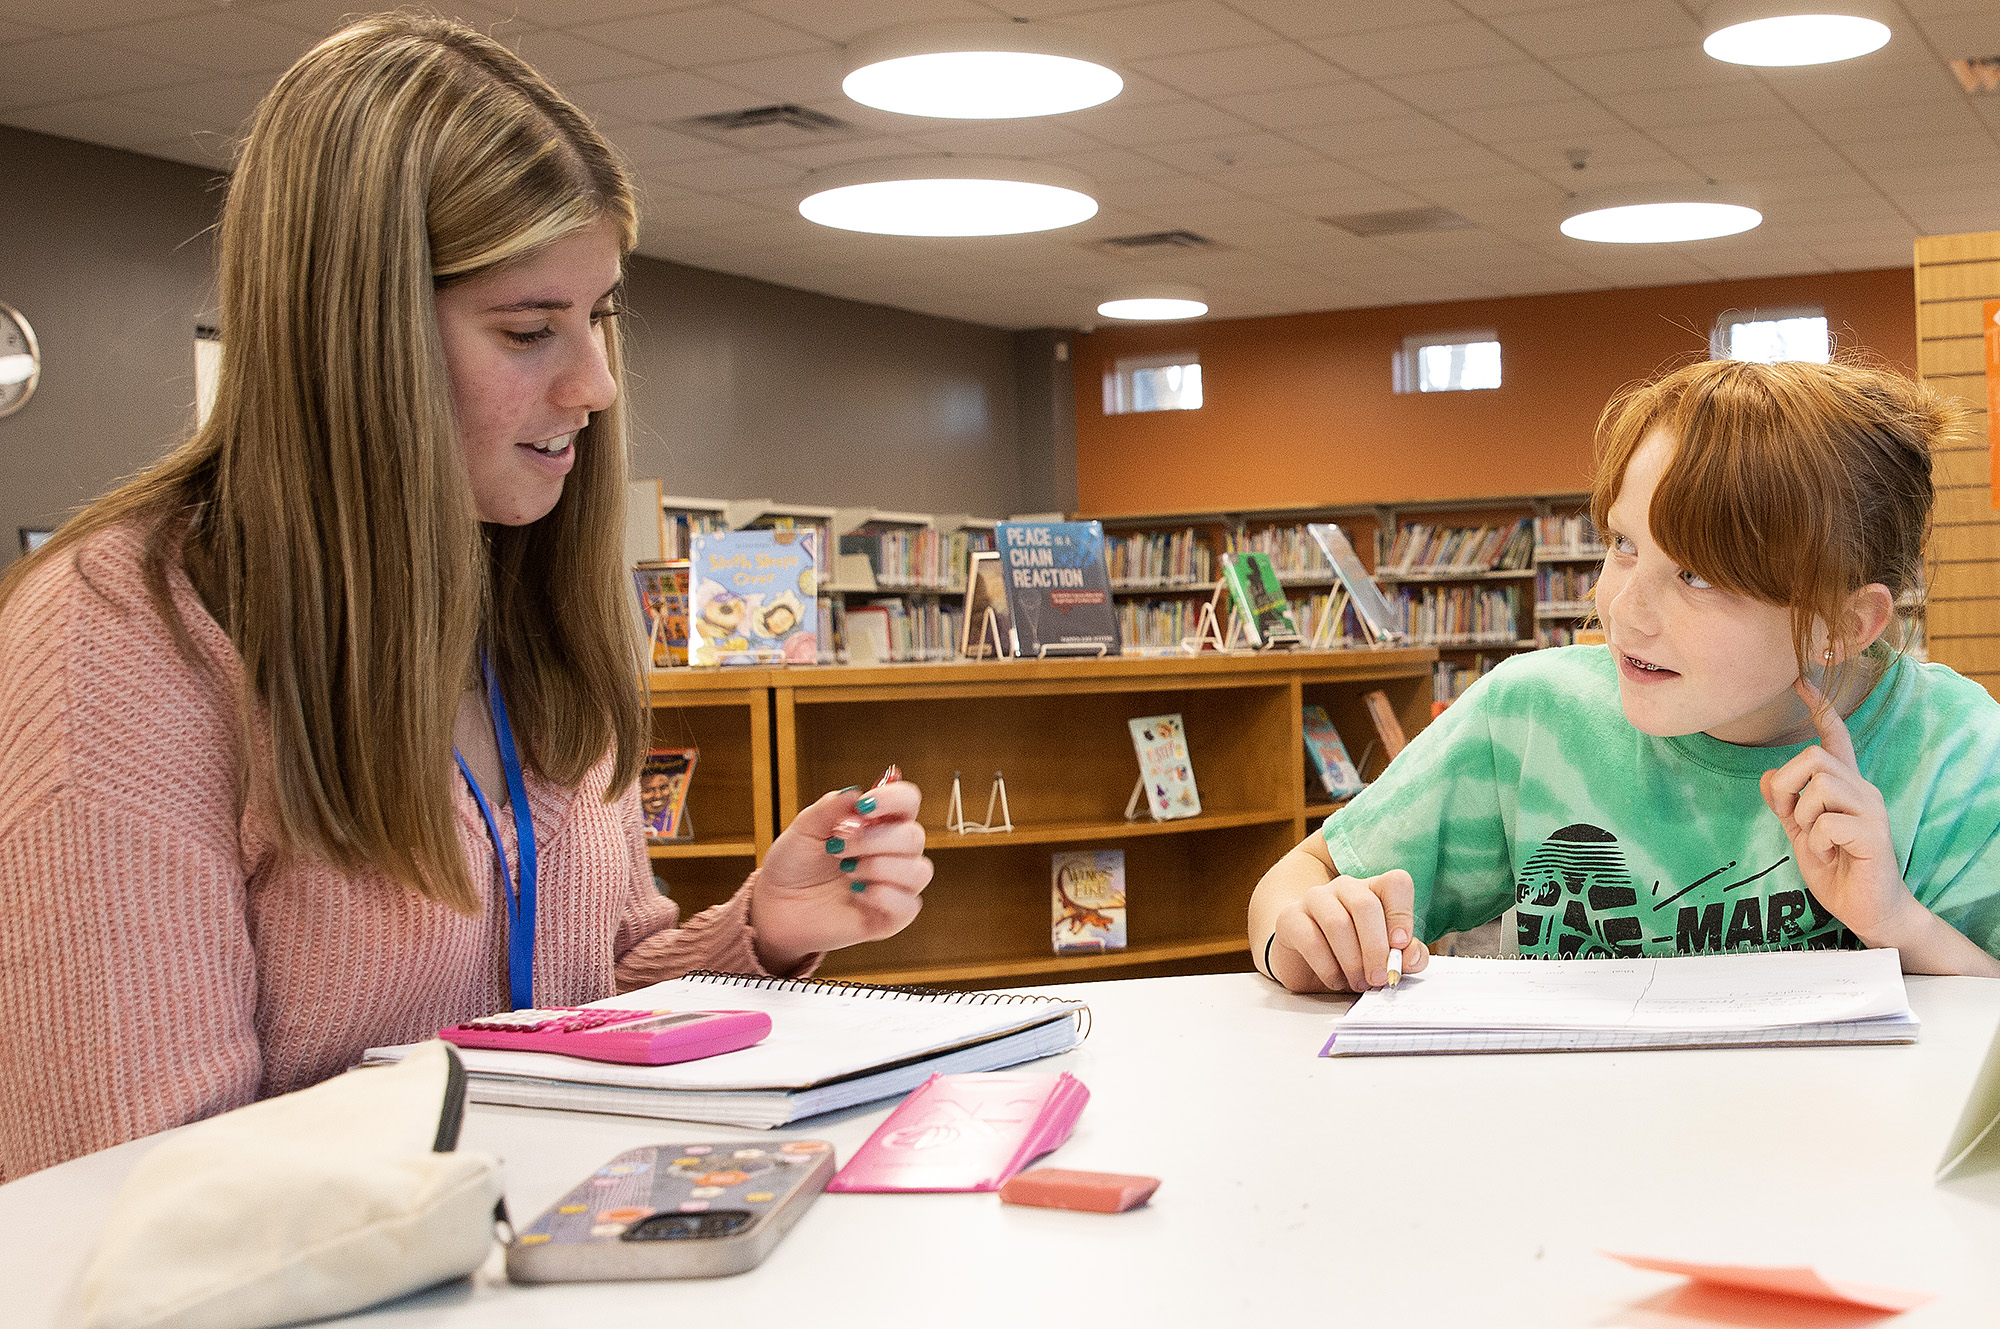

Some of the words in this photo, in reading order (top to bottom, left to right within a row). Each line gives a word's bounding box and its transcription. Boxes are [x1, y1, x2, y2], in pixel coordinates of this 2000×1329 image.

[1006, 527, 1052, 547] PEACE
[709, 553, 752, 571] Sloth
[1009, 548, 1054, 568] CHAIN
[733, 571, 775, 586] Over
[1012, 567, 1085, 589] REACTION
